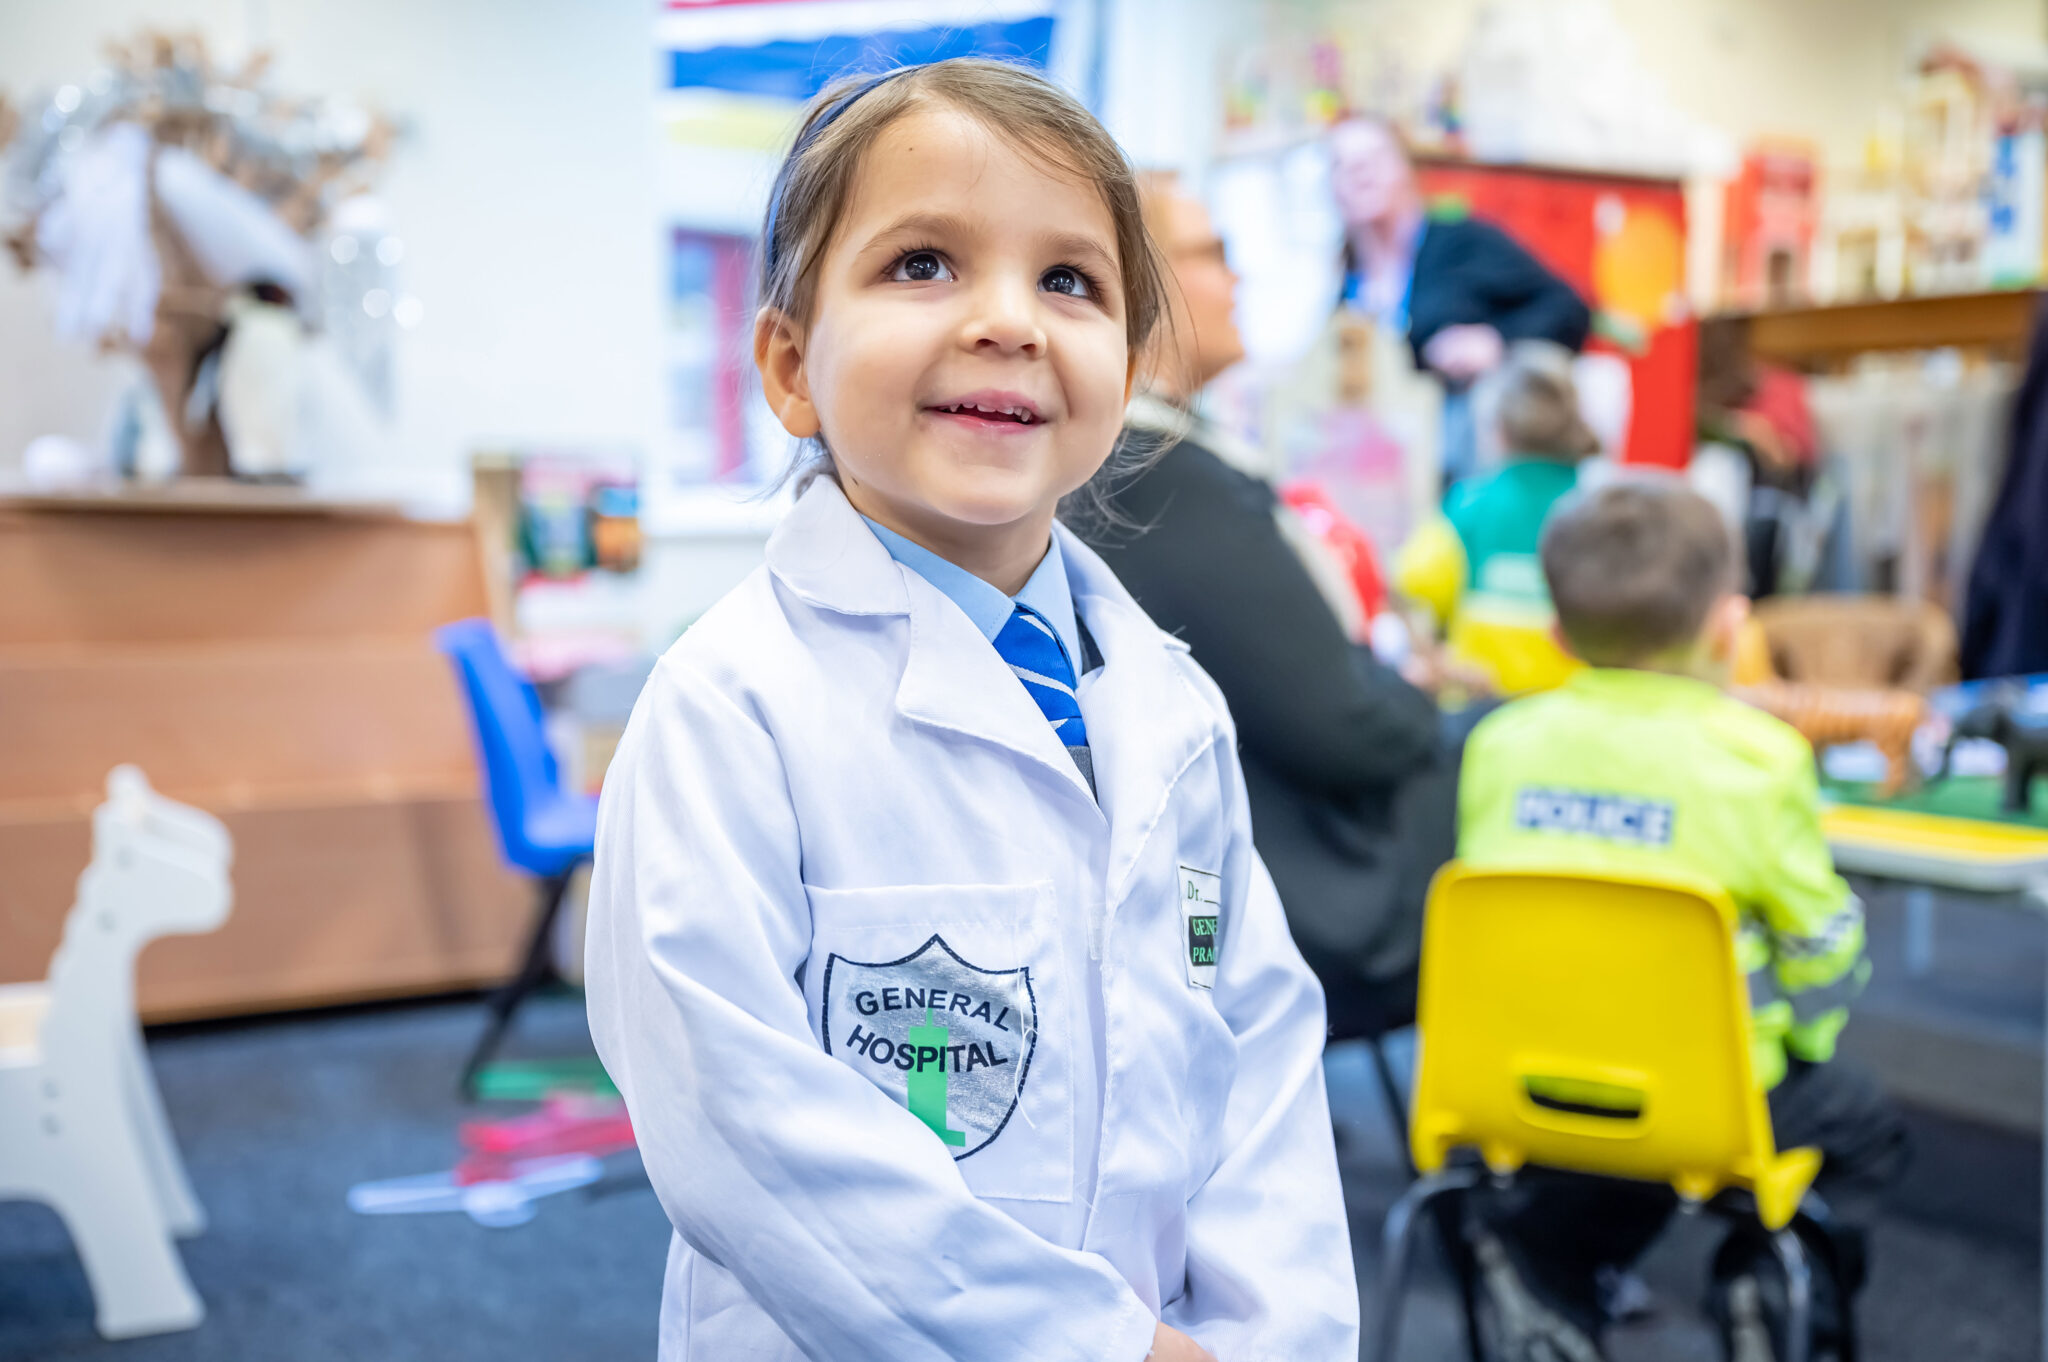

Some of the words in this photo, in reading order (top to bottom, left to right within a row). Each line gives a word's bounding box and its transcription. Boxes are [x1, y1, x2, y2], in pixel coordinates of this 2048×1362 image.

[1519, 788, 1671, 844] POLICE
[855, 987, 1009, 1032] GENERAL
[846, 1024, 1008, 1073] HOSPITAL
